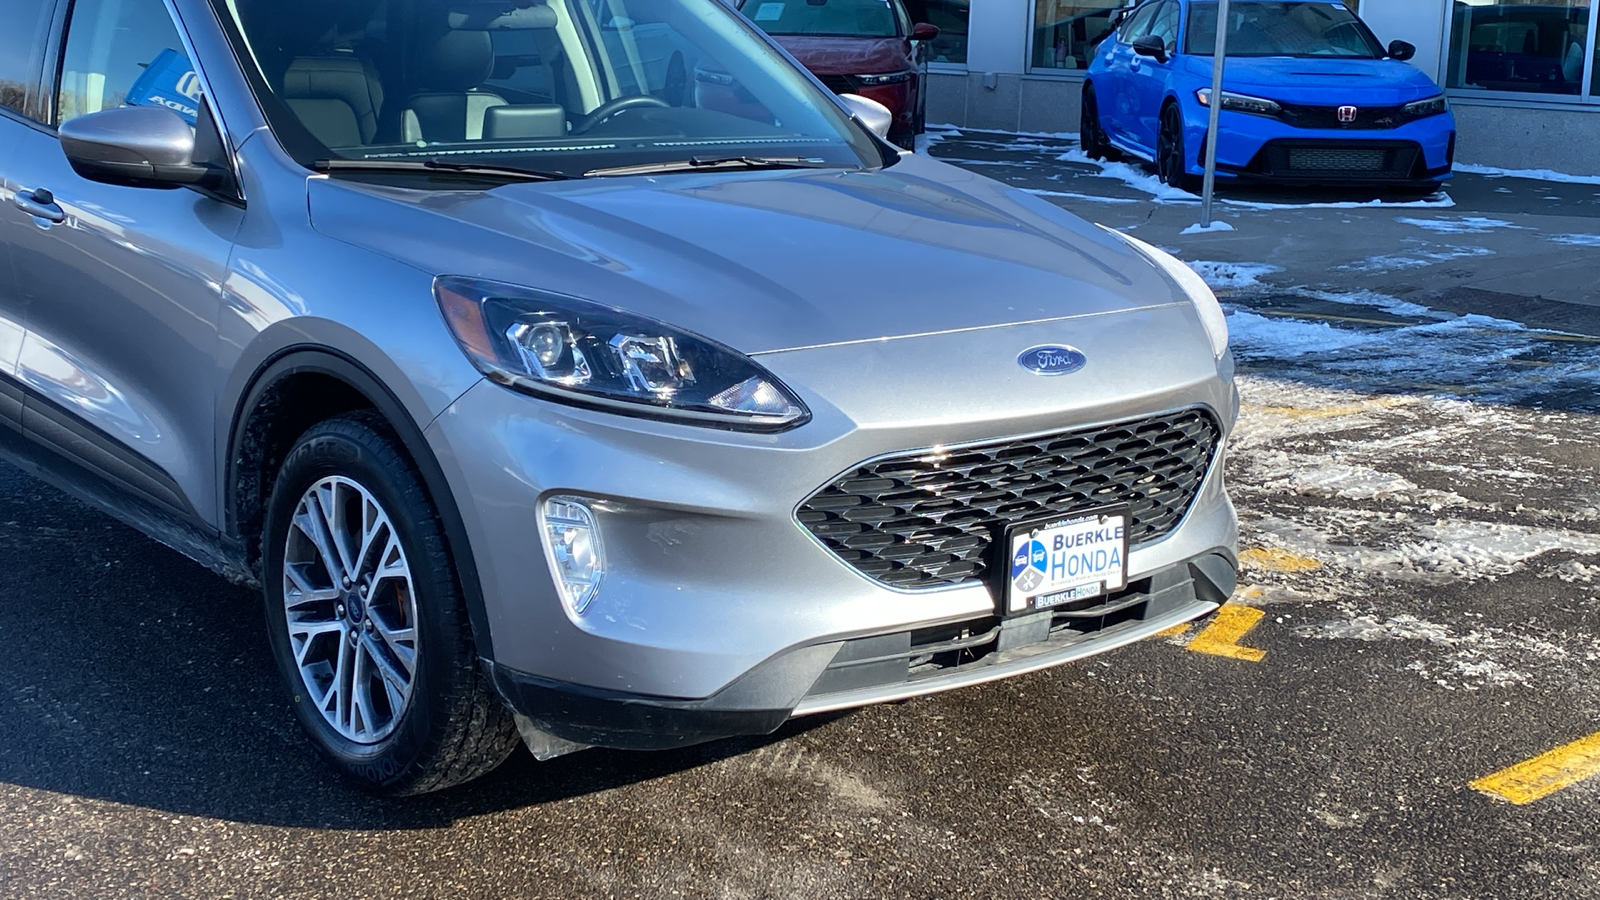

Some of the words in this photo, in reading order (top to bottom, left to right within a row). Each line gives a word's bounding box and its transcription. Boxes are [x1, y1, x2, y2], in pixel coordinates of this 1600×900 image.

[1036, 349, 1073, 368] Ford
[1053, 526, 1124, 551] BUERKLE
[1051, 547, 1121, 581] HONDA
[1037, 589, 1076, 607] BUERKLE
[1076, 585, 1098, 598] HONDA
